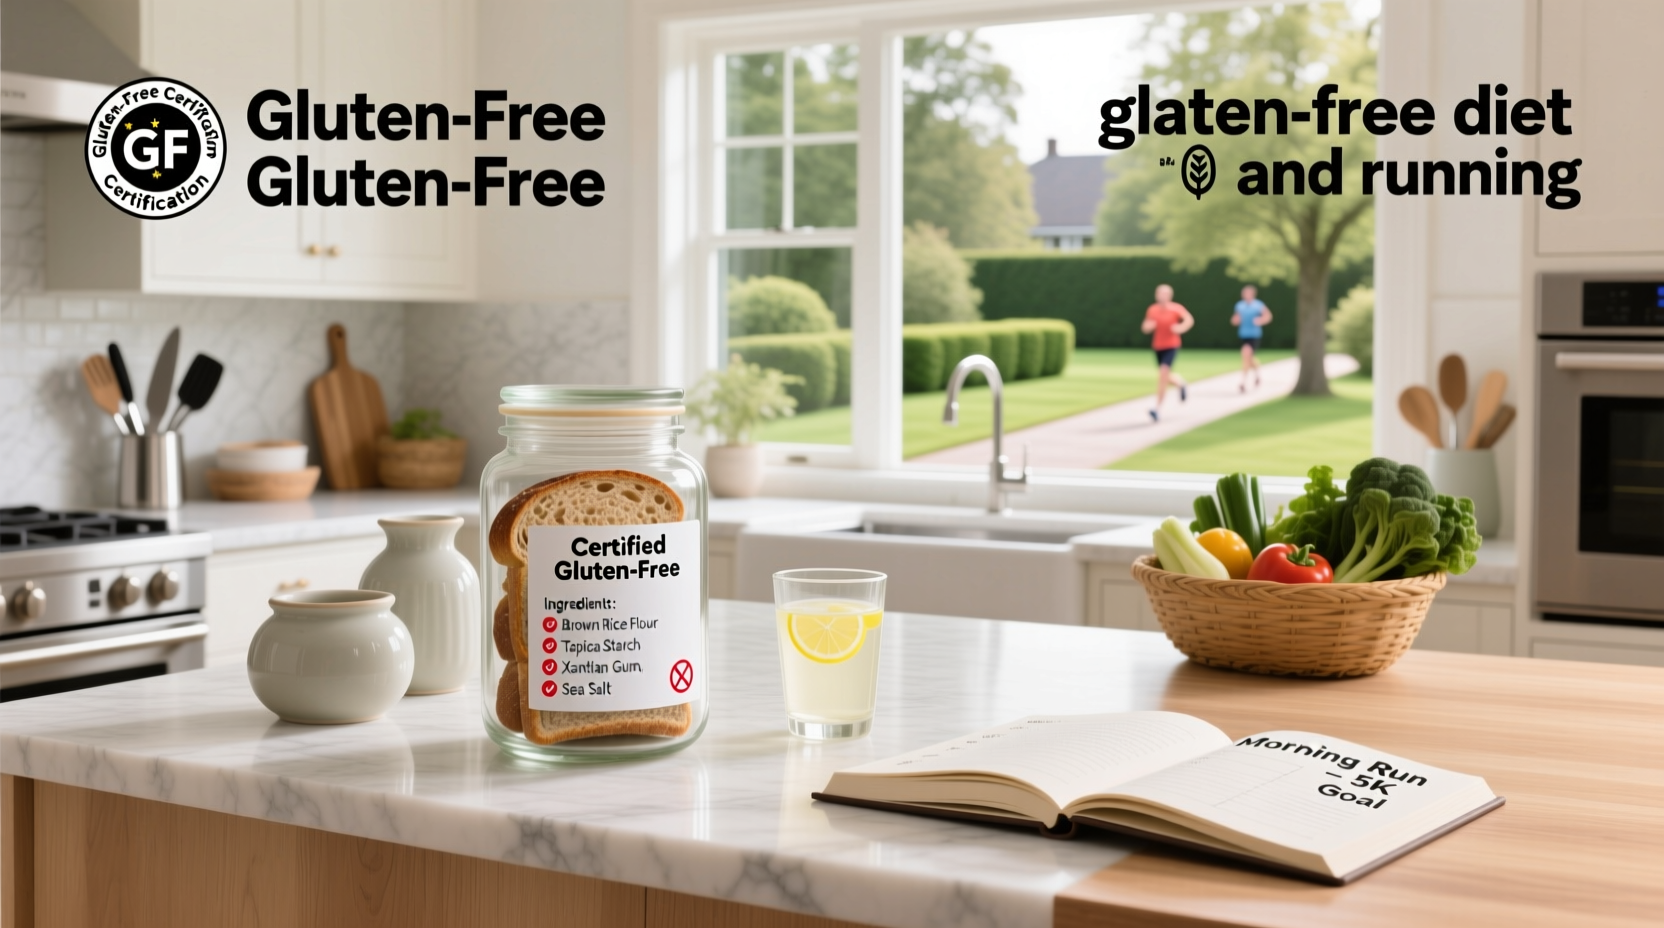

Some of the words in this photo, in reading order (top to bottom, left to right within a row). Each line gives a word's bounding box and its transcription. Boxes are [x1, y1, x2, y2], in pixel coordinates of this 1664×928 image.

[571, 533, 666, 557] Certified
[554, 559, 680, 581] Gluten-Free
[561, 618, 600, 631] Brown
[602, 617, 628, 631] Rice
[630, 616, 659, 630] Flour
[602, 637, 641, 652] Starch
[561, 682, 585, 696] Sea
[588, 681, 612, 696] Salt
[1235, 737, 1361, 770] Morning
[1367, 761, 1428, 787] Run
[1350, 774, 1397, 796] 5K
[1317, 784, 1387, 809] Goal
